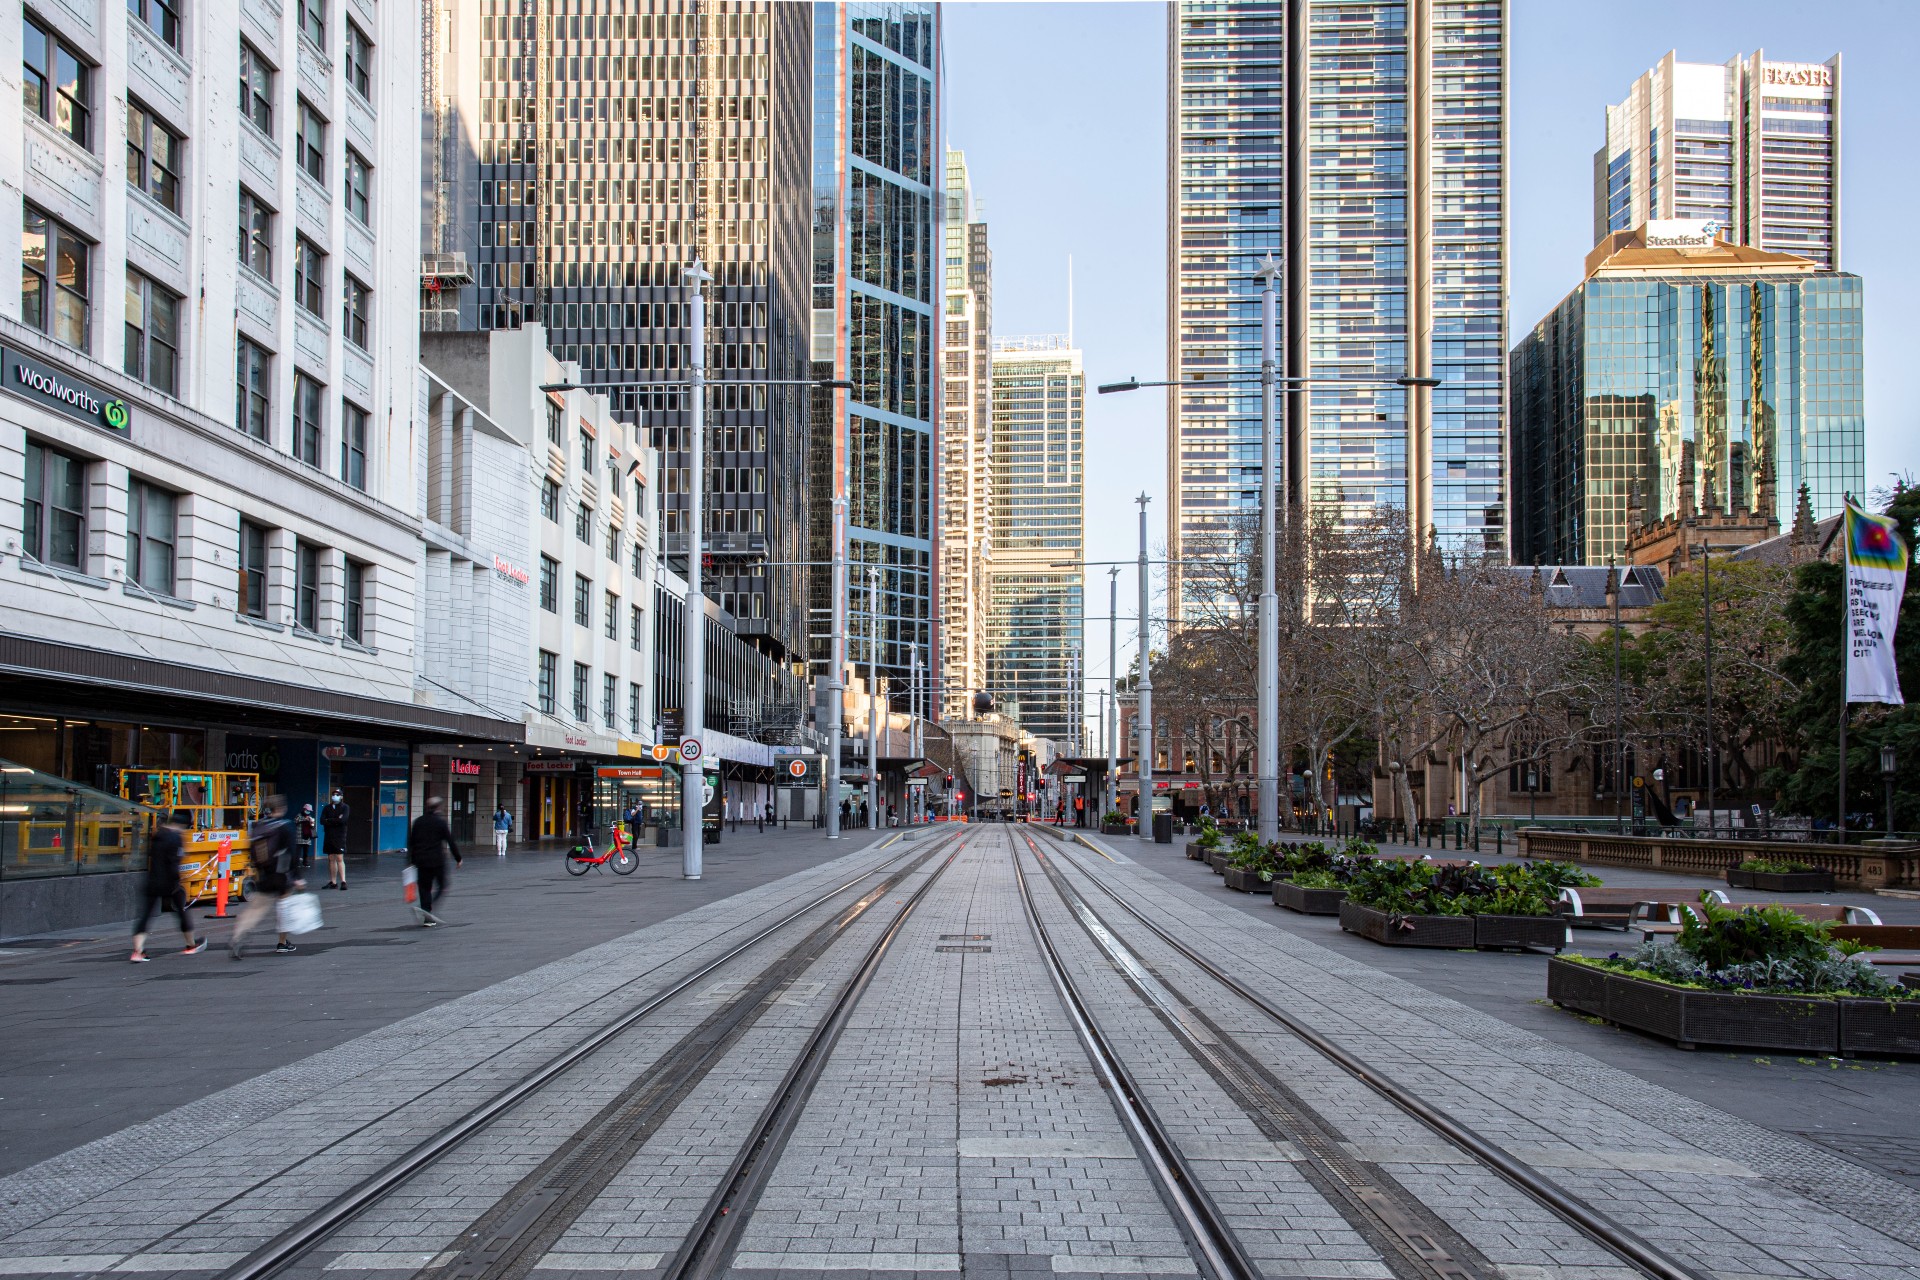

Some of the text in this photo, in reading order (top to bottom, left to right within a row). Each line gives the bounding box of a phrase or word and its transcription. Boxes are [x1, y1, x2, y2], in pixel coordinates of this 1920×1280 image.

[1762, 67, 1832, 87] FRASER
[1647, 235, 1708, 246] Steadfast
[18, 364, 100, 415] Woolworths
[495, 554, 509, 574] Foot
[510, 563, 529, 584] Locker
[1853, 639, 1864, 647] IN
[575, 735, 587, 746] Locker
[685, 745, 698, 755] 20
[456, 759, 480, 775] Locker
[527, 761, 545, 769] Foot
